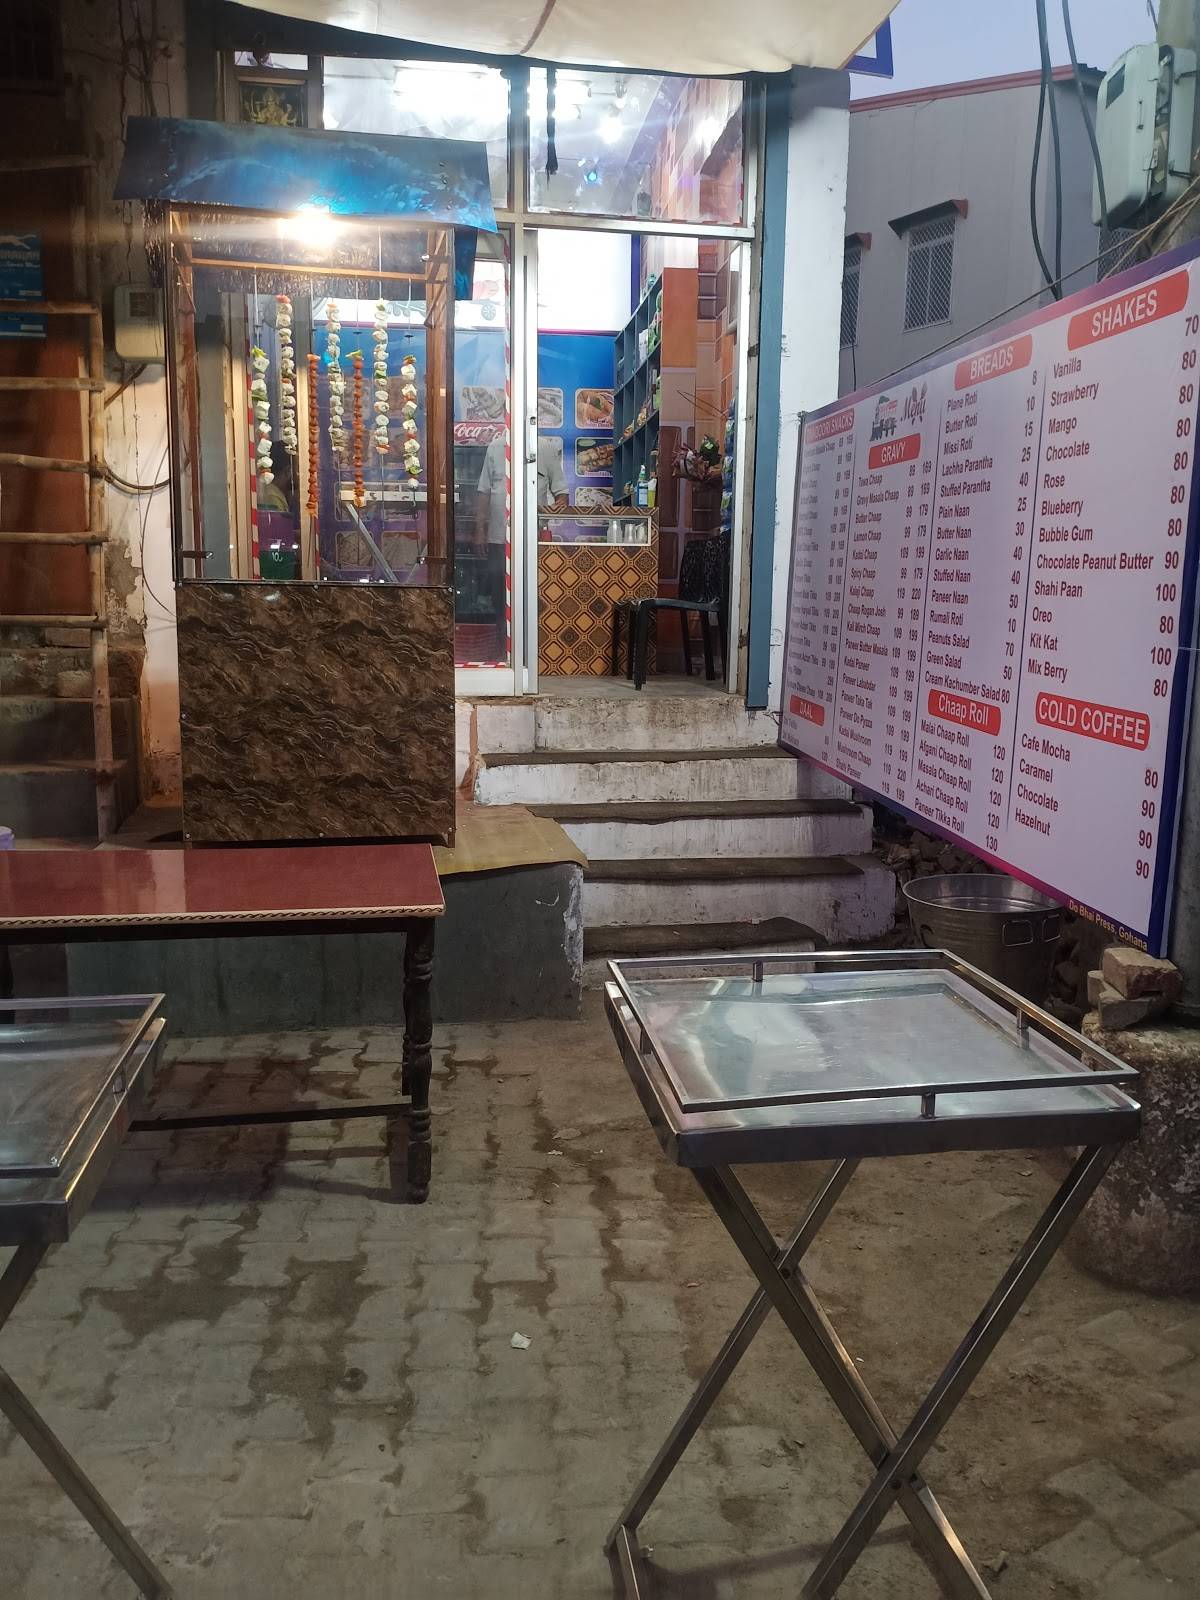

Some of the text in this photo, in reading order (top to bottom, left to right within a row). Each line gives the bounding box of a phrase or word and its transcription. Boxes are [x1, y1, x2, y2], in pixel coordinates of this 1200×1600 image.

[1092, 289, 1158, 337] SHAKES
[970, 345, 1014, 380] BREADS
[1053, 314, 1200, 380] Vanilla 70
[1032, 370, 1038, 386] 8
[1050, 349, 1197, 407] Strawberry 80
[945, 396, 1036, 434] Butter Roti 10
[1048, 384, 1194, 435] Mango 80
[881, 441, 906, 463] GRAVY
[944, 422, 1033, 456] Missi Roti 15
[1021, 446, 1031, 462] 25
[1046, 418, 1191, 462] Chocolate 80
[940, 482, 962, 498] Stuffed
[1020, 472, 1028, 487] 40
[1044, 451, 1188, 489] Rose 80
[938, 497, 1027, 519] Plain Naan 25
[1041, 484, 1185, 518] Blueberry 80
[936, 522, 1024, 540] Butter Naan 30
[1039, 518, 1182, 543] Bubble Gum 80
[936, 546, 1022, 560] Garlic Naan 40
[1036, 551, 1179, 570] Chocolate Peanut Butter 90
[934, 568, 1020, 584] Stuffed Naan 40
[1034, 580, 1176, 602] Shahi Paan 100
[932, 589, 1018, 608] Paneer Naan 50
[930, 610, 1016, 632] Rumali Roti 10
[1032, 606, 1174, 634] Oreo 80
[928, 630, 1014, 656] Peanuts Salad 70
[1030, 632, 1172, 666] Kit Kat 100
[926, 650, 1012, 680] Green Salad 50
[1028, 658, 1168, 698] Mix Berry 80
[925, 670, 1010, 704] Cream Kachumber Salad 80
[938, 694, 989, 726] Chaap Roll
[1038, 697, 1147, 746] COLD COFFEE
[920, 720, 1006, 761] Malai Chaap Roll 120
[919, 740, 1004, 784] Afgani Chaap Roll 120
[1022, 733, 1158, 789] Cafe Mocha 80
[918, 758, 1002, 807] Masala Chaap Roll 120
[1019, 758, 1156, 819] Caramel 90
[914, 798, 998, 852] Paneer Tikka Roll 130
[936, 787, 954, 809] Chaap
[956, 796, 968, 814] Roll
[988, 812, 1000, 830] 120
[1017, 783, 1152, 850] Chocolate 90
[1015, 807, 1150, 880] Hazelnut 90
[1069, 900, 1078, 913] Do
[1080, 905, 1094, 922] Bhai
[1118, 926, 1148, 951] Gohana
